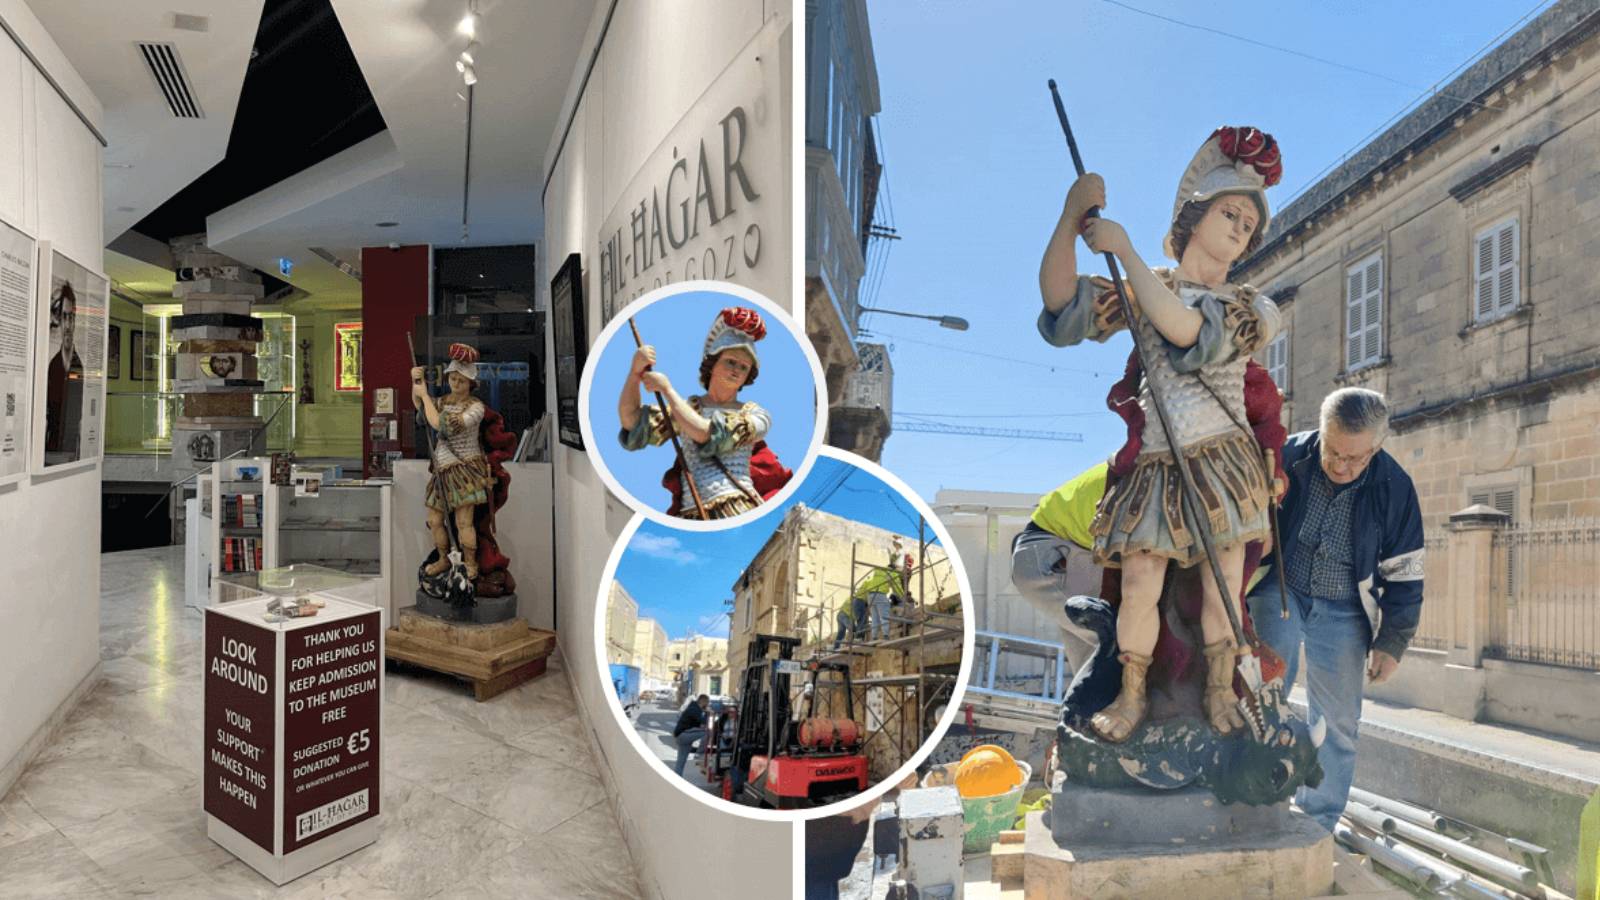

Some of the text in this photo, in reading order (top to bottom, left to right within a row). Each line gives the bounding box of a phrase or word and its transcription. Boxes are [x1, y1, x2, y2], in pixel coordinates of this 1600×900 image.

[222, 636, 257, 666] LOOK
[304, 623, 365, 648] THANK YOU
[291, 640, 375, 672] FOR HELPING US
[211, 656, 268, 694] AROUND
[289, 659, 376, 694] KEEP ADMISSION
[288, 678, 376, 714] TO THE MUSEUM
[225, 708, 251, 734] YOUR
[321, 706, 347, 724] FREE
[217, 728, 260, 762] SUPPORT
[293, 728, 371, 762] SUGGESTED €5
[211, 748, 267, 790] MAKES THIS
[293, 753, 340, 778] DONATION
[306, 773, 335, 790] WHATEVER
[335, 769, 346, 778] YOU
[346, 765, 357, 775] CAN
[358, 761, 369, 770] GIVE
[219, 776, 257, 810] HAPPEN
